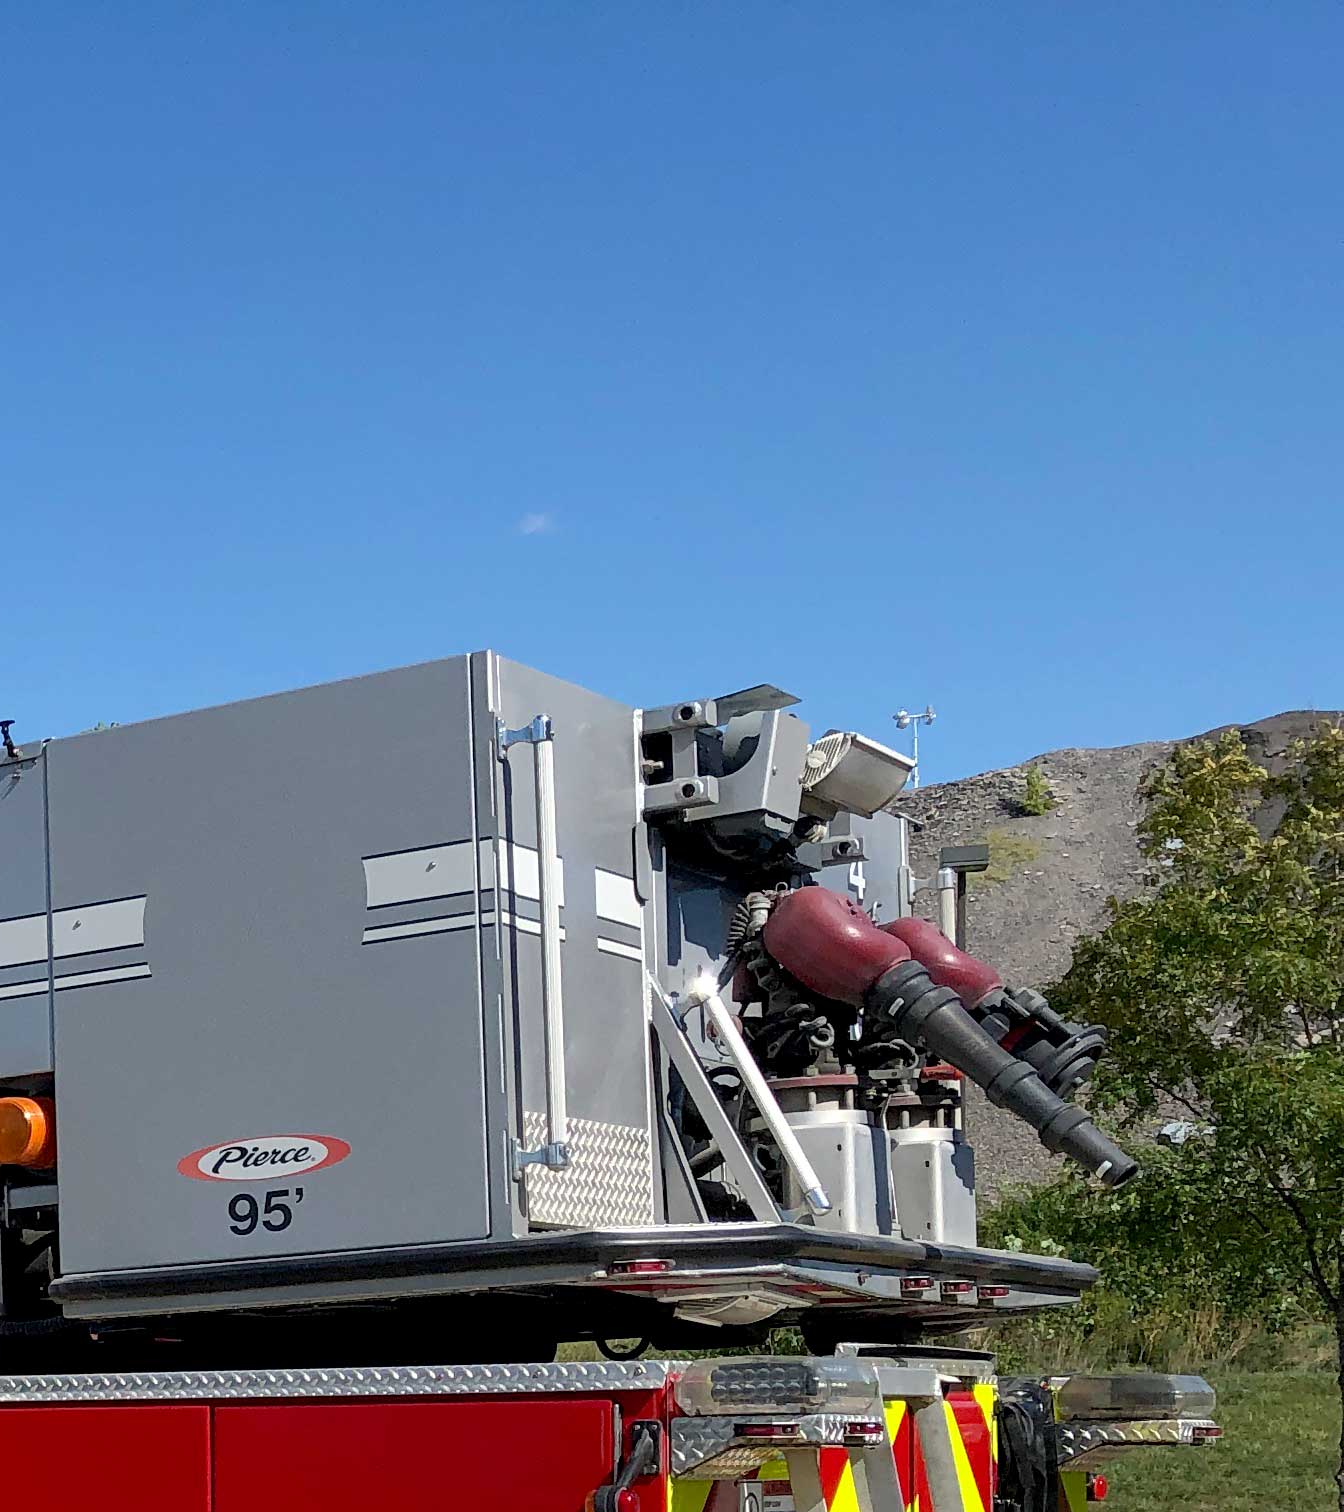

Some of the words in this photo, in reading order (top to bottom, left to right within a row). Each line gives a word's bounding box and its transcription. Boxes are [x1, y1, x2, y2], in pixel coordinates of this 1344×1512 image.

[849, 861, 866, 900] 4
[212, 1146, 312, 1174] Pierce
[228, 1187, 304, 1236] 95'
